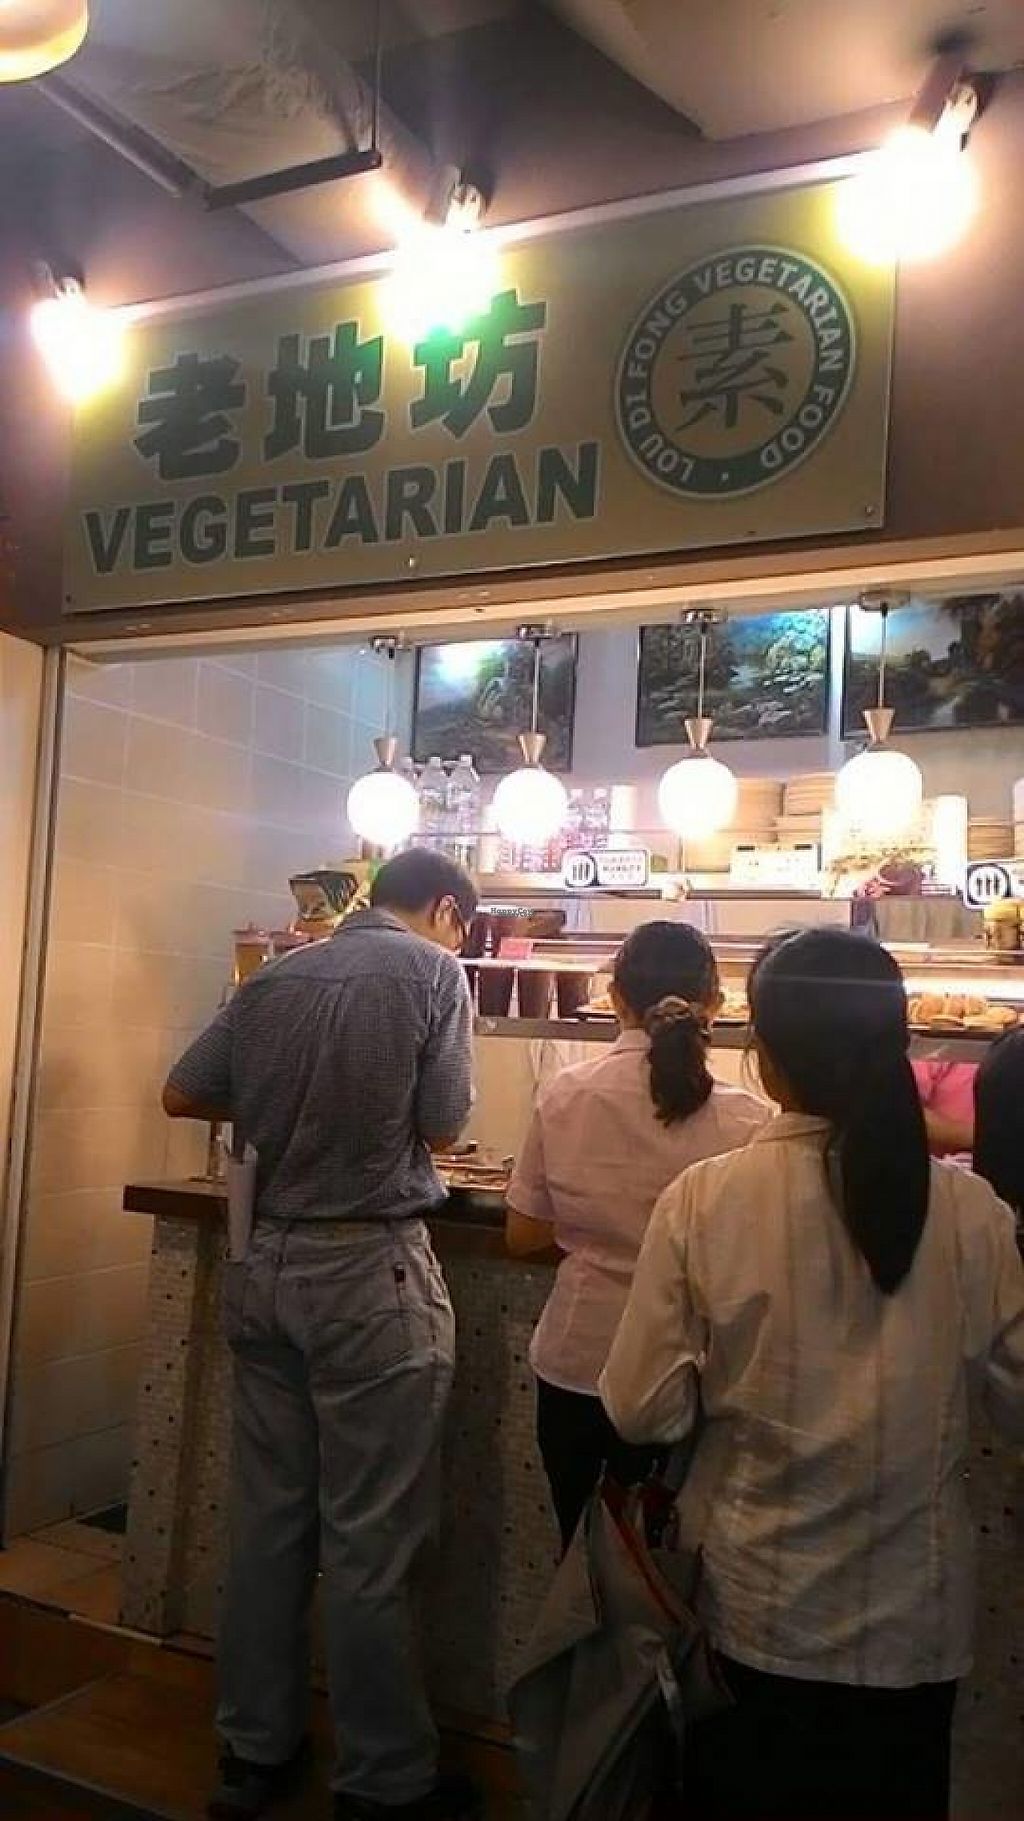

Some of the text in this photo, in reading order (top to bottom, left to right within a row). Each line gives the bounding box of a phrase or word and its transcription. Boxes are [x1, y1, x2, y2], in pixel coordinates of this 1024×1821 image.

[133, 288, 547, 480] 老地坊
[626, 256, 845, 483] LOU DI FONG VEGETARIAN FOOD
[672, 302, 794, 432] 素
[84, 441, 599, 574] VEGETARIAN
